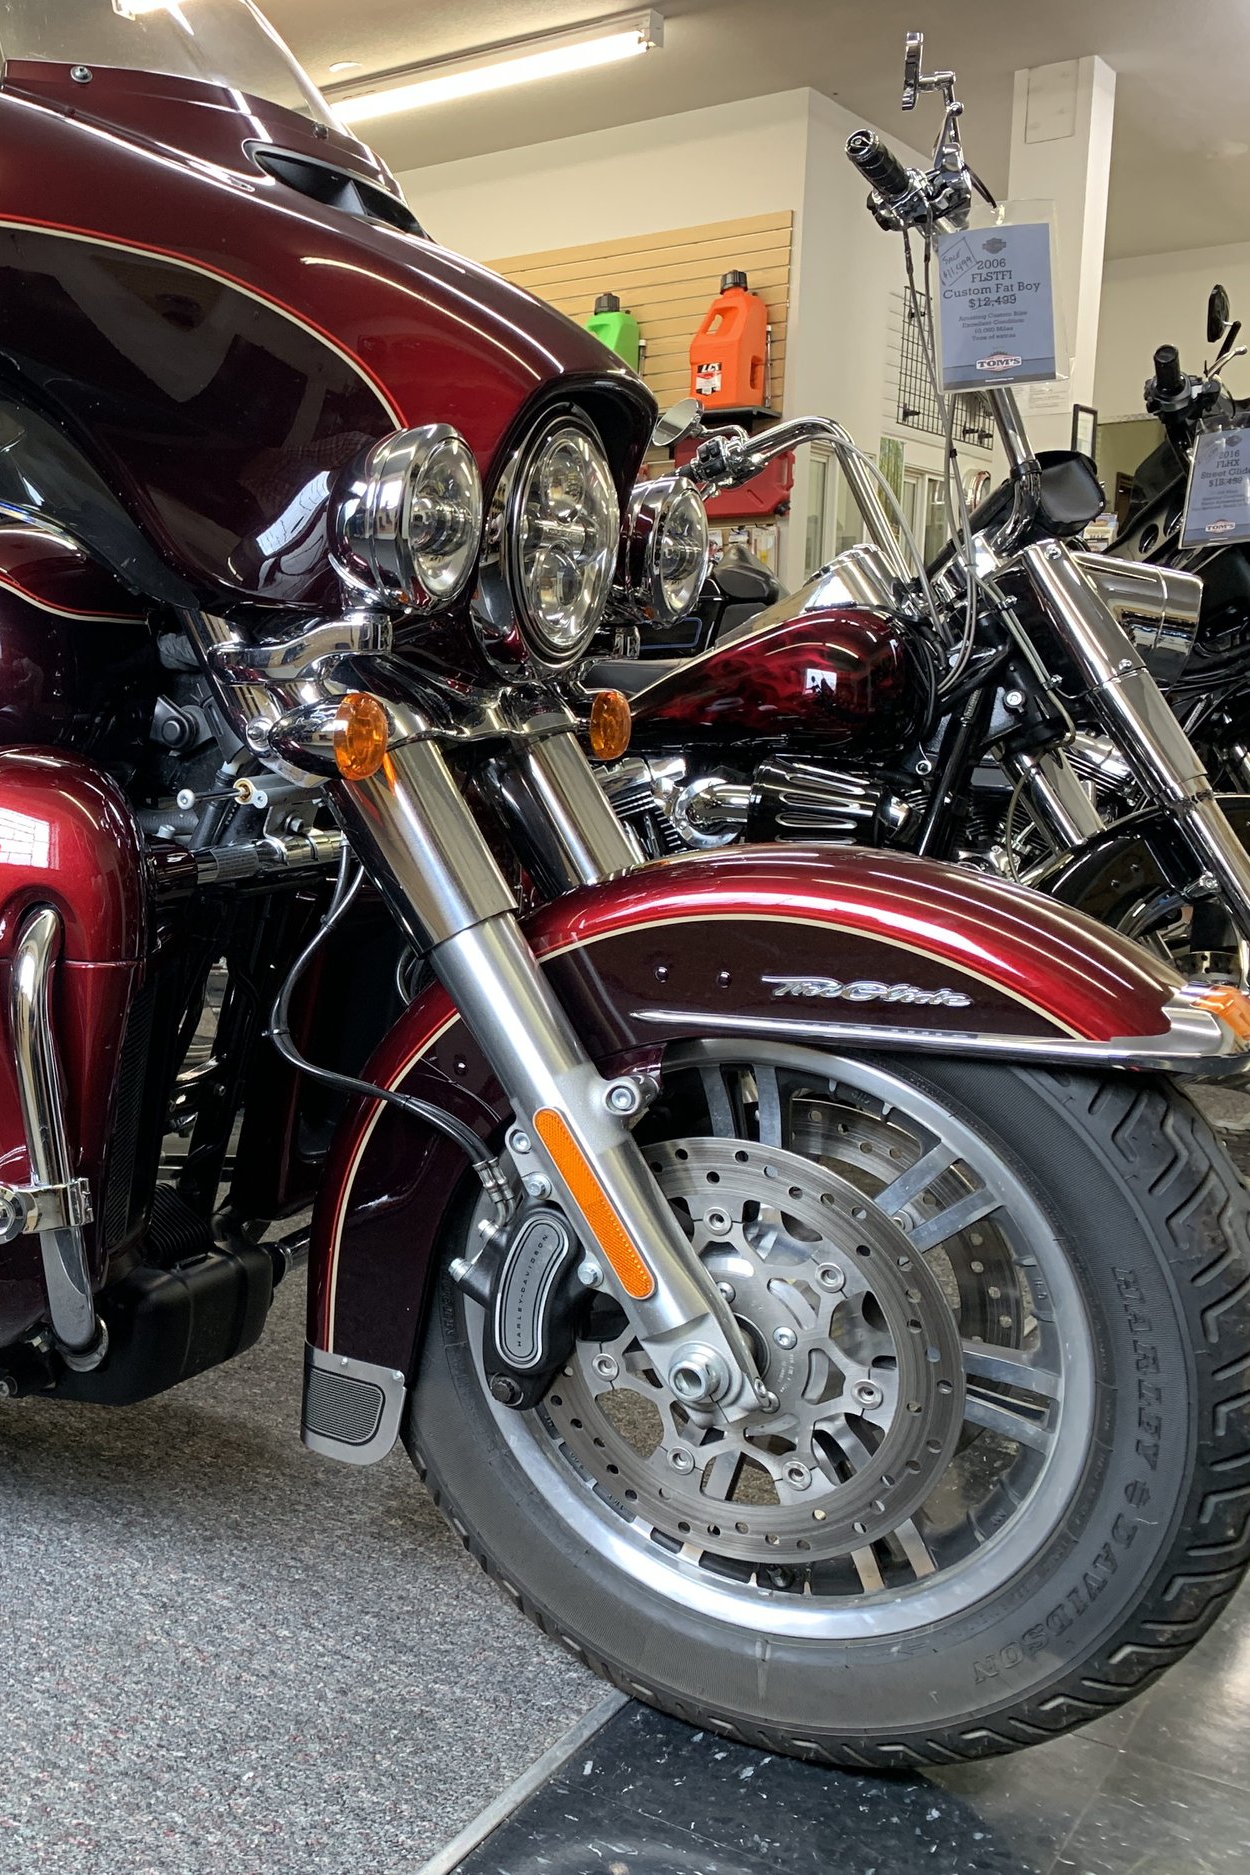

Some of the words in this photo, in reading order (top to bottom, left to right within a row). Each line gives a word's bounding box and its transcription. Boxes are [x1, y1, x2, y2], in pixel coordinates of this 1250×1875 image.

[977, 258, 1006, 270] 2006
[971, 270, 1012, 283] FLSTFI
[943, 287, 992, 299] Custom
[995, 283, 1014, 293] Fat
[1017, 281, 1040, 292] Boy
[968, 294, 1017, 308] $12,499
[977, 358, 1021, 368] TOM'S
[516, 1234, 549, 1348] HARLEY-DAVIDSON
[1111, 1266, 1162, 1472] HARLEY
[972, 1512, 1138, 1685] DAVIDSON
